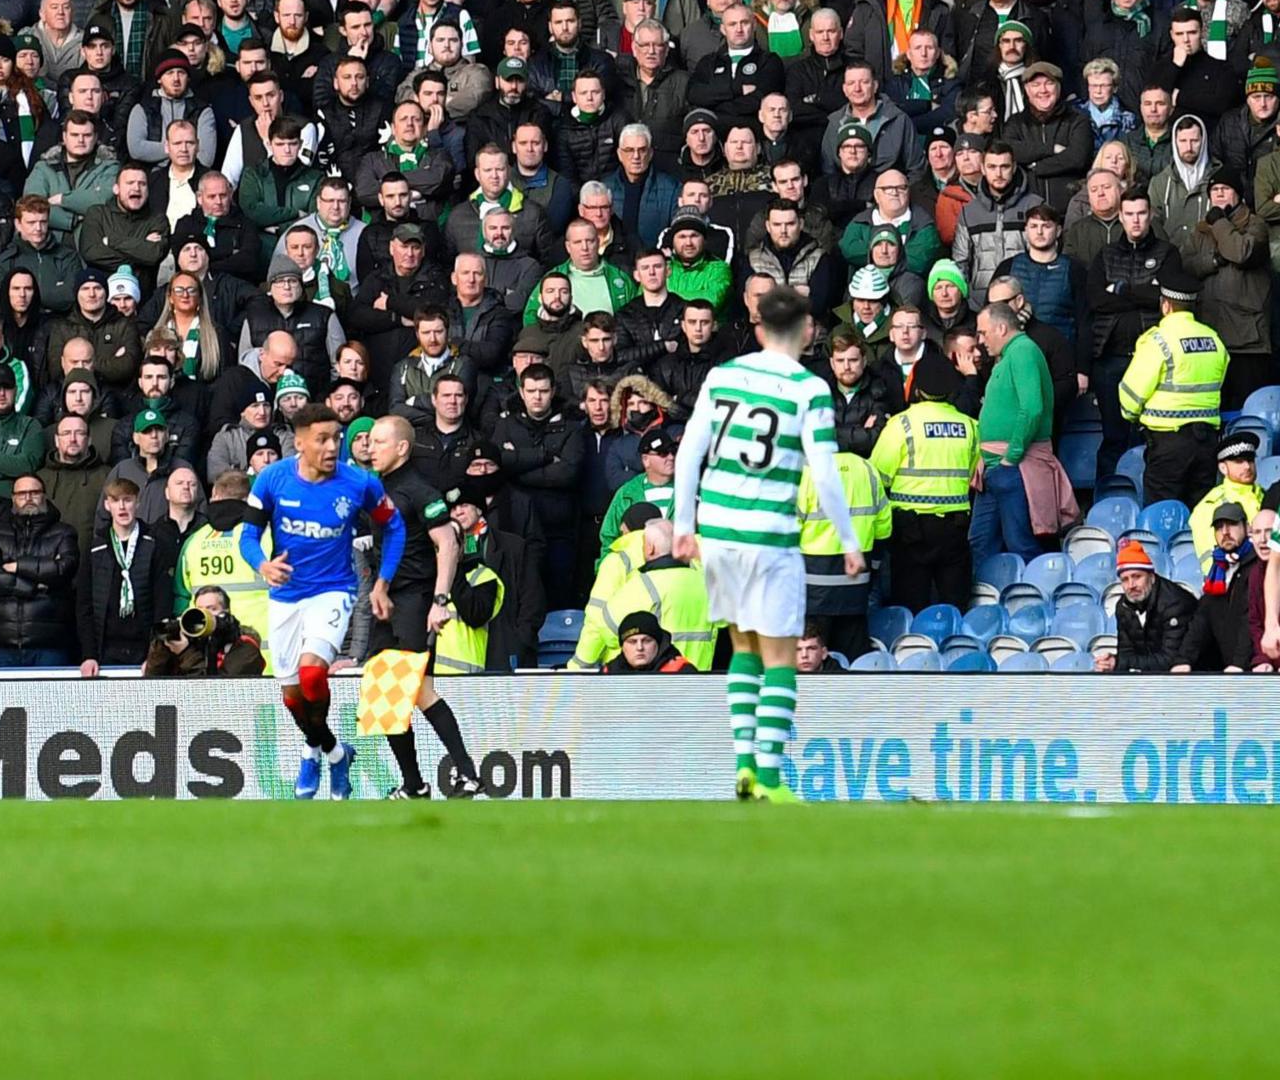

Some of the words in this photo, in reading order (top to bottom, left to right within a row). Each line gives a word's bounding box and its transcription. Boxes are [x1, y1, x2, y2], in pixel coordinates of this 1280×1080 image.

[1182, 338, 1217, 353] POLICE
[710, 398, 779, 470] 73
[925, 422, 966, 438] POLICE
[280, 516, 345, 539] 32Red
[200, 555, 234, 576] 590
[930, 708, 1097, 802] time.
